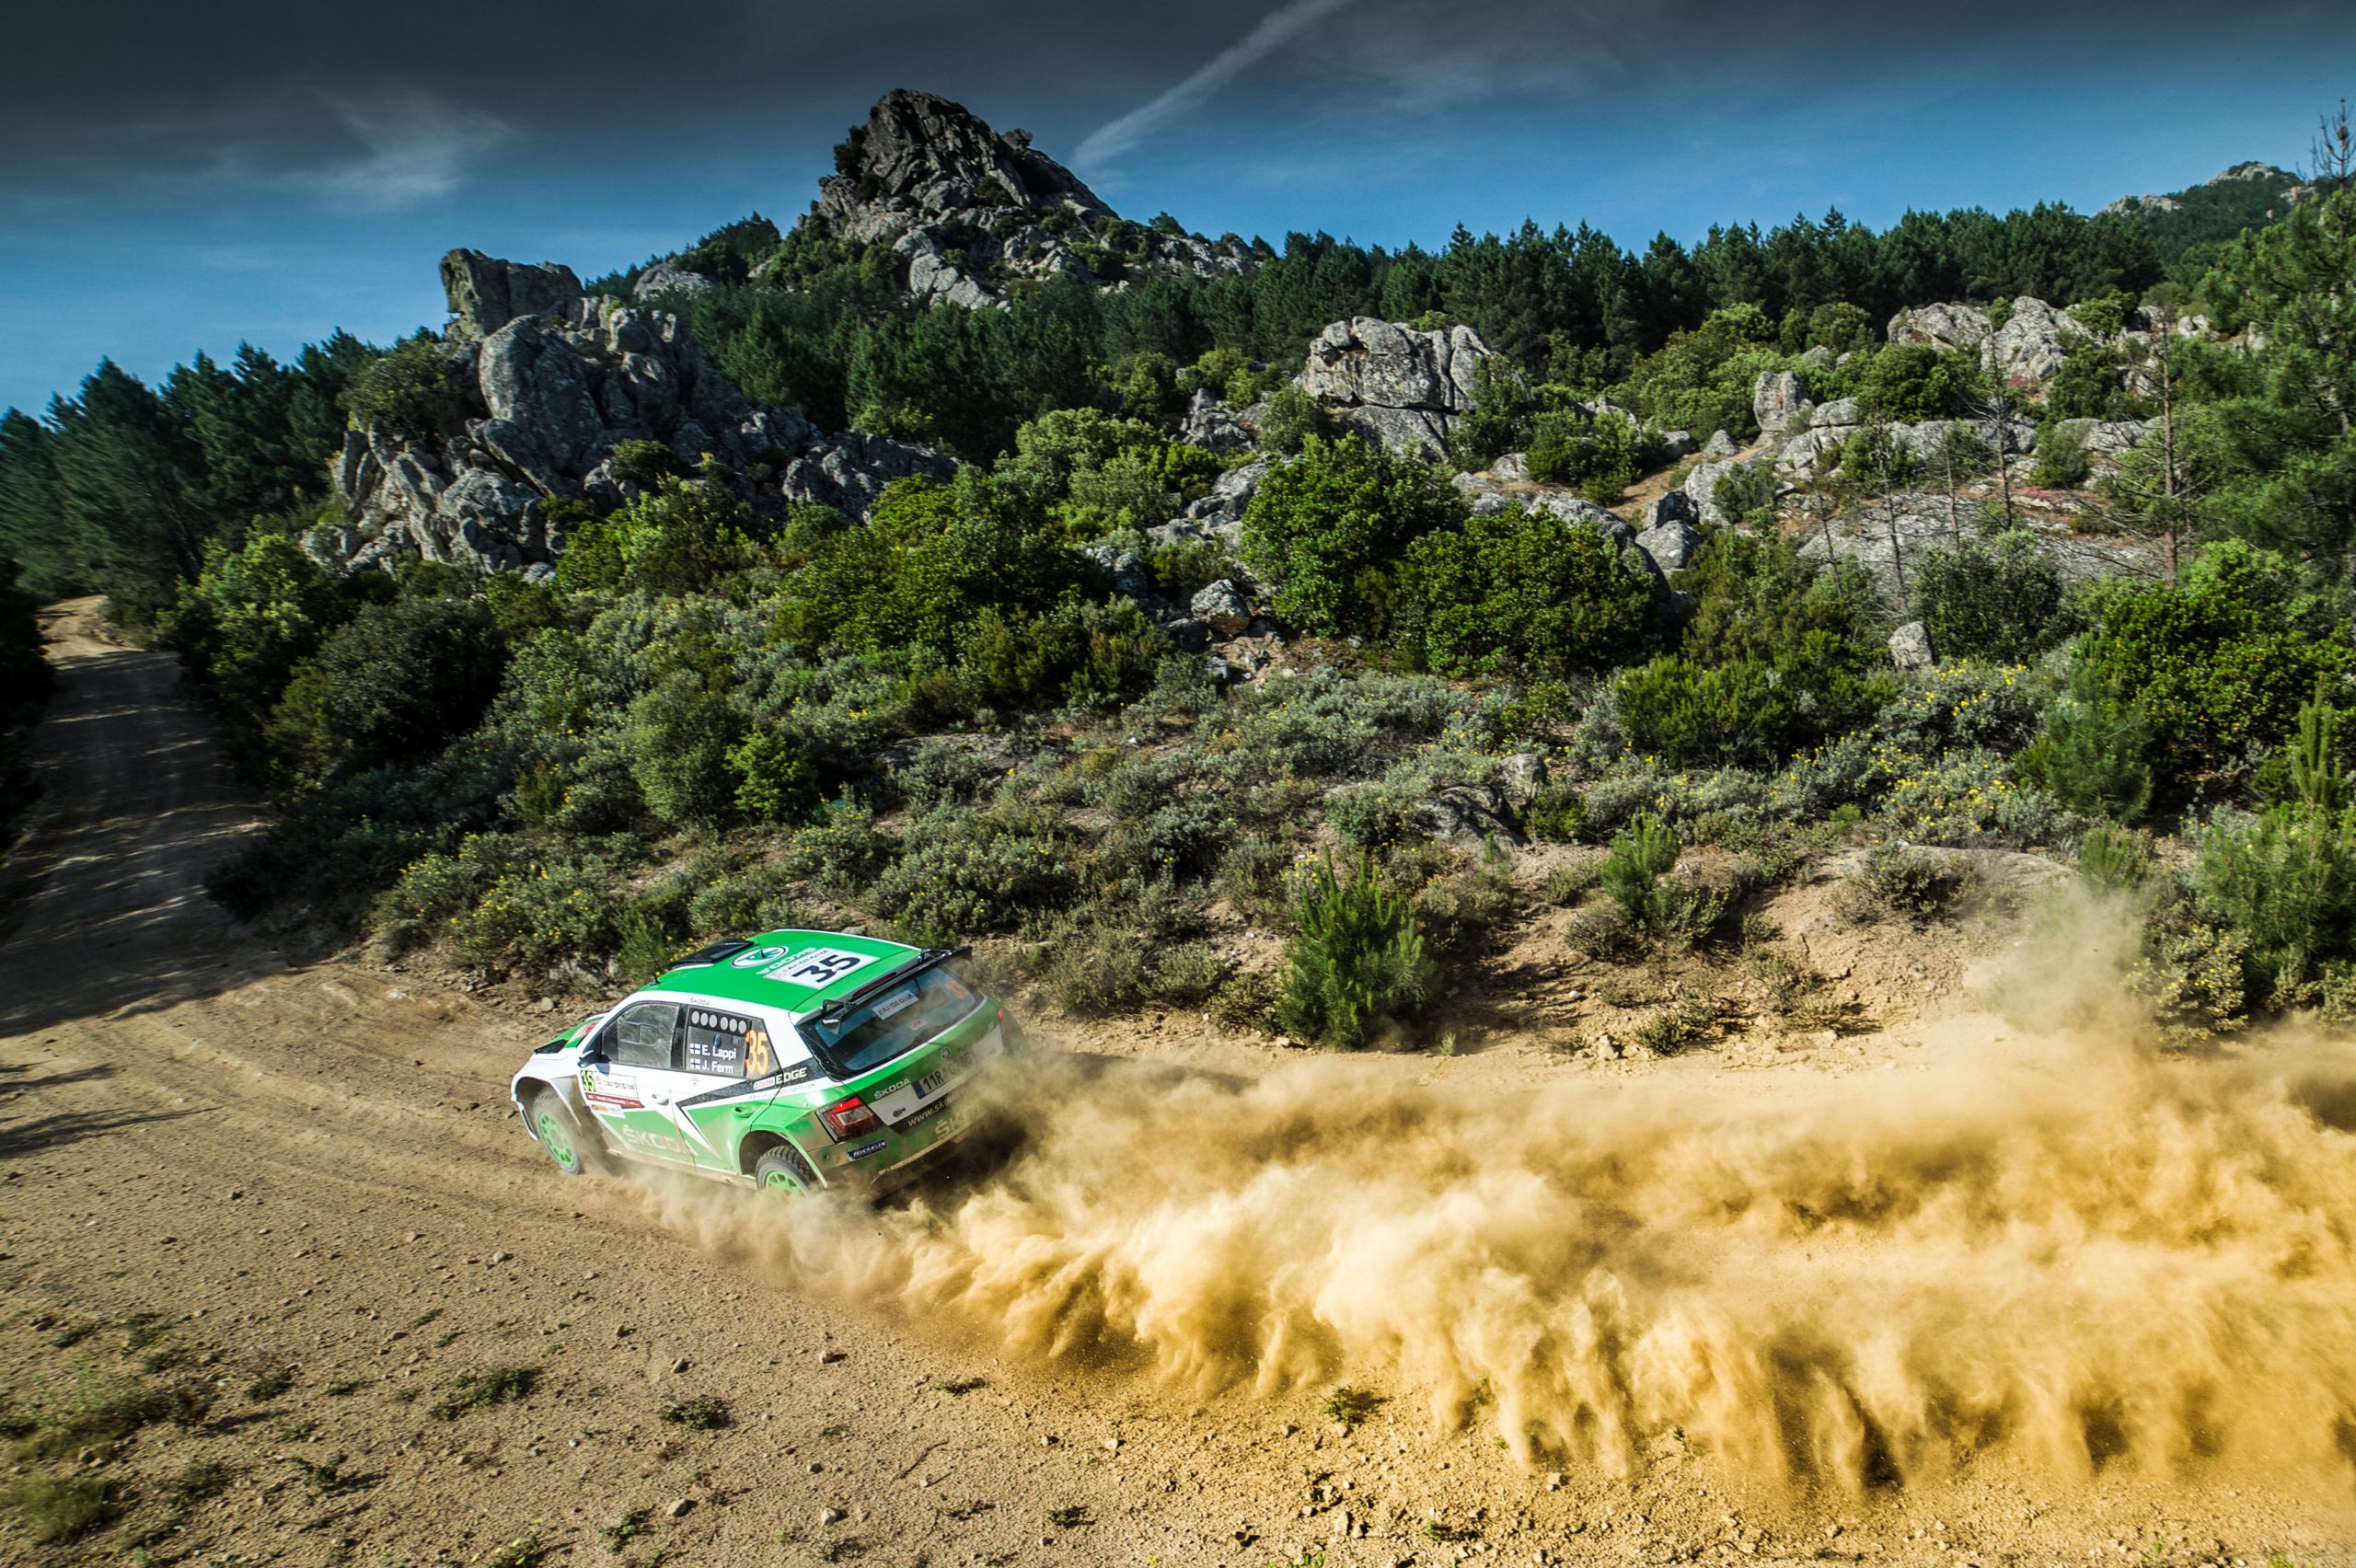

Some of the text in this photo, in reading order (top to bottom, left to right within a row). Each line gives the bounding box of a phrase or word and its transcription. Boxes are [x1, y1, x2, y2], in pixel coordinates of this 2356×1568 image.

[791, 954, 861, 983] 35
[701, 1044, 737, 1060] E. Lappi
[745, 1030, 768, 1075] 35
[701, 1059, 734, 1074] J. Ferm
[776, 1066, 807, 1085] EDGE
[873, 1078, 911, 1100] ŠKODA
